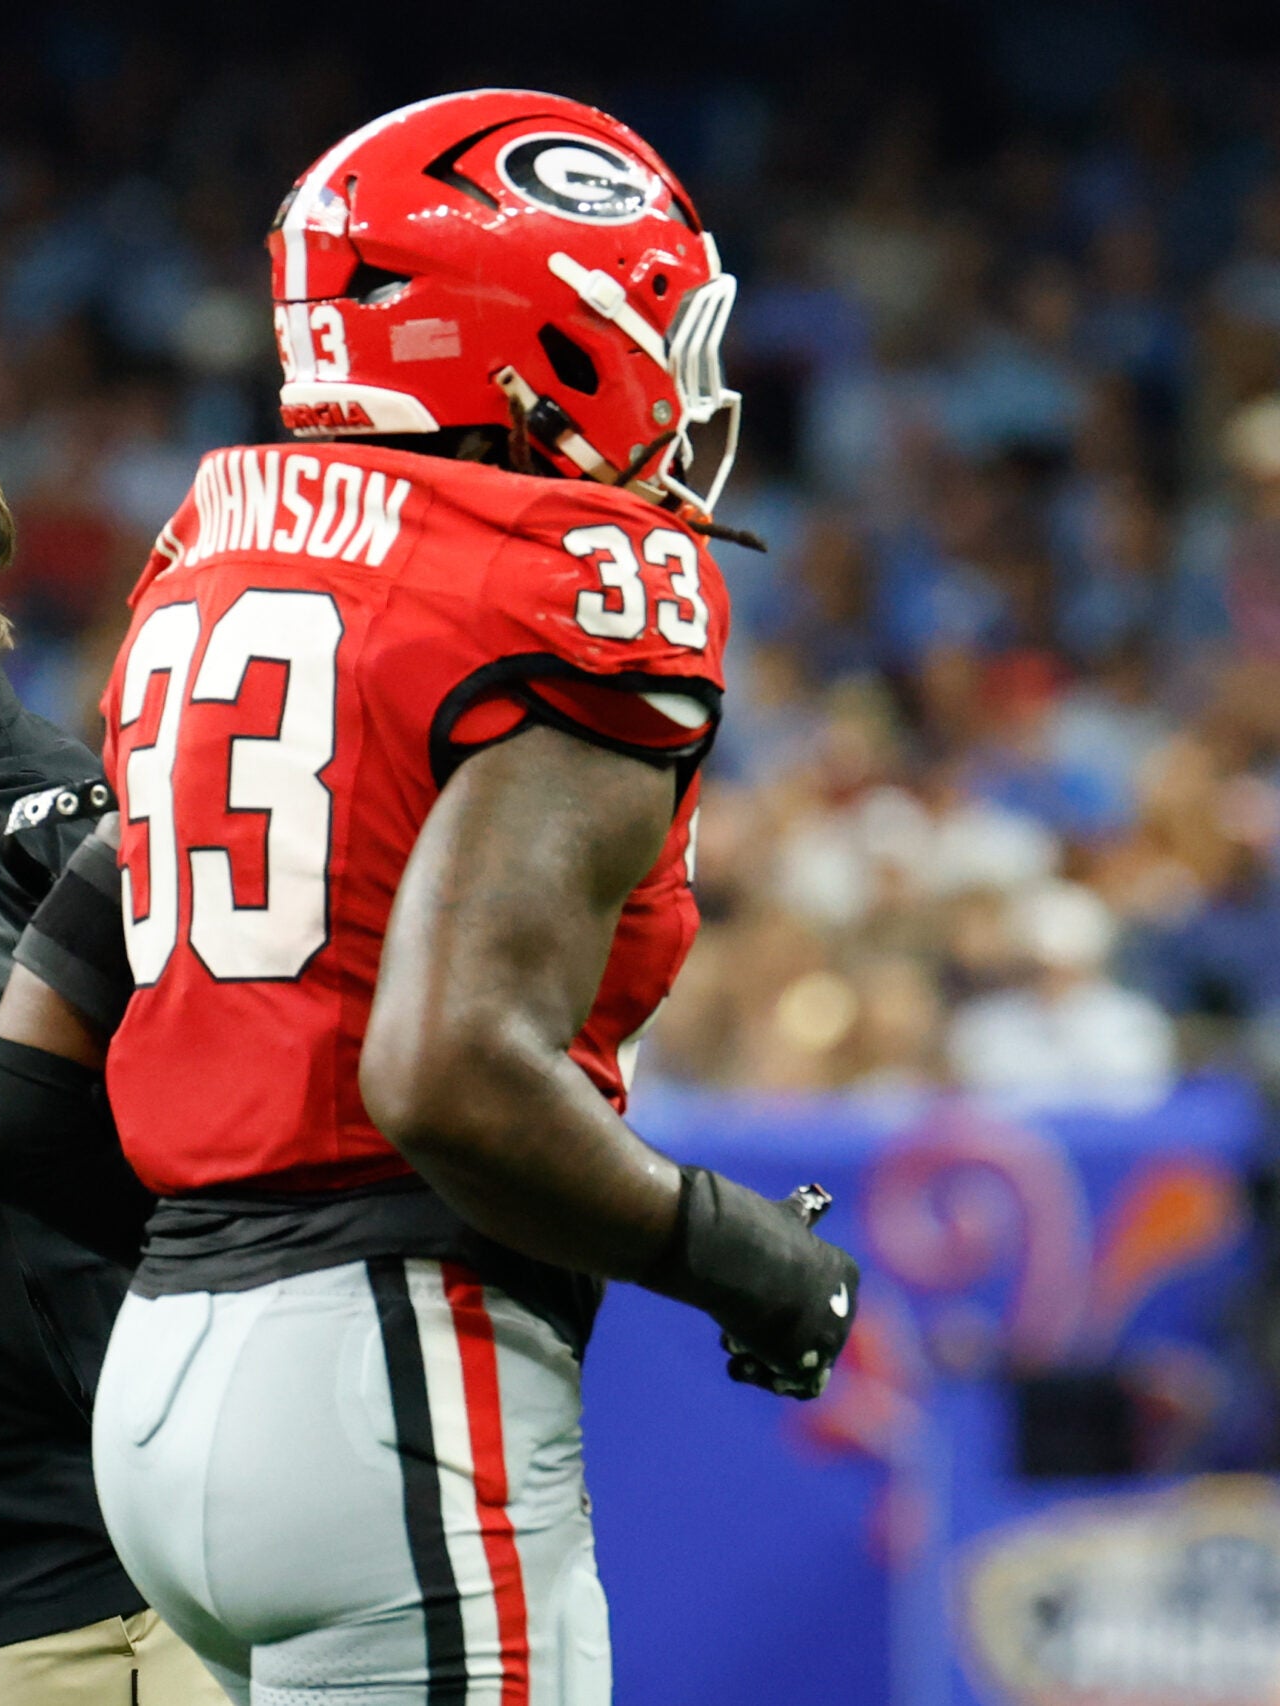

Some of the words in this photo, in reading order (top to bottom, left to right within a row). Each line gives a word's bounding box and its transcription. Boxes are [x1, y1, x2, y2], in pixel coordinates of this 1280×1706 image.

[502, 136, 648, 219] G
[184, 449, 412, 568] JOHNSON
[562, 524, 709, 652] 33
[120, 587, 344, 990] 33
